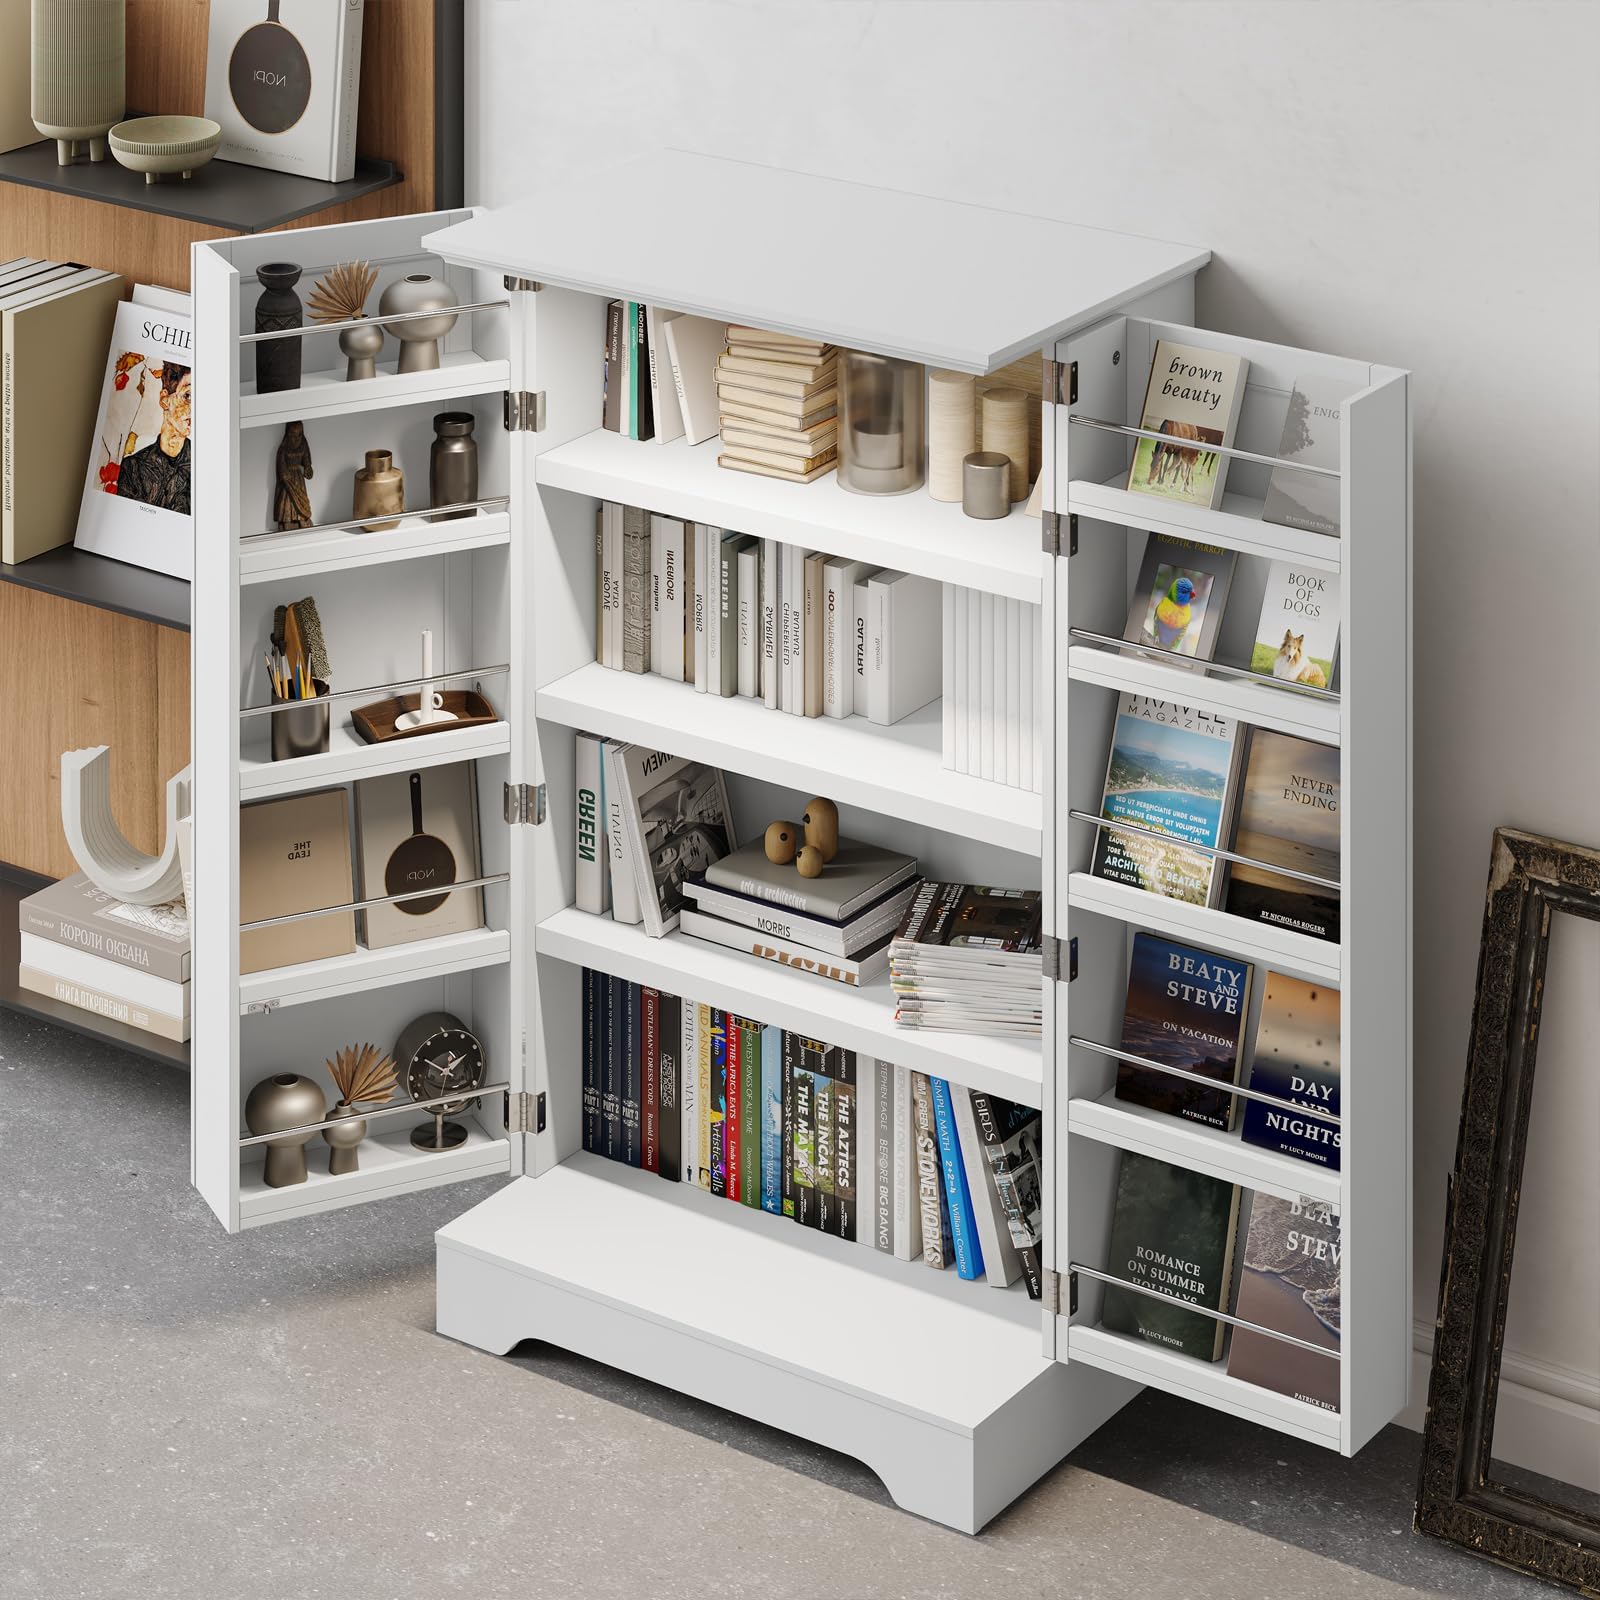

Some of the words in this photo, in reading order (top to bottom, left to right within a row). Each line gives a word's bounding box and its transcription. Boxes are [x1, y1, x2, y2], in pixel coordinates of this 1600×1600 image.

[1168, 356, 1223, 383] brown
[1161, 378, 1221, 410] beauty
[1288, 572, 1326, 592] BOOK
[1296, 588, 1313, 602] OF
[1283, 598, 1321, 618] DOGS
[1128, 704, 1227, 738] MAGAZINE
[1290, 774, 1334, 796] NEVER
[1136, 801, 1171, 816] PERSPICIATIS
[1172, 810, 1188, 820] UNDE
[1190, 814, 1207, 825] OMNIS
[1283, 791, 1338, 812] ENDING
[1113, 805, 1126, 814] ISTE
[1126, 808, 1144, 818] NATUS
[1146, 813, 1164, 824] ERROR
[1165, 818, 1174, 826] SIT
[1175, 822, 1210, 837] VOLUPTATEM
[1107, 846, 1121, 854] TORE
[1108, 836, 1127, 846] EAQUE
[1103, 868, 1119, 878] VITAE
[1120, 872, 1136, 883] DICTA
[1166, 872, 1201, 889] BEATAE
[757, 917, 791, 938] MORRIS
[1261, 910, 1269, 918] BY
[1270, 912, 1300, 926] NICHOLAS
[1301, 920, 1326, 934] ROGERS
[60, 921, 103, 951] КОРОЛИ
[106, 938, 150, 967] ОКЕАНА
[1168, 953, 1241, 988] BEATY
[55, 982, 79, 1005] КНИГА
[80, 990, 128, 1021] ОТКРОВЕНИЯ
[1166, 980, 1238, 1015] STEVE
[1214, 985, 1239, 998] AND
[1162, 1020, 1178, 1032] ON
[1180, 1026, 1233, 1049] VACATION
[700, 1029, 709, 1090] ANIMALS
[746, 1088, 753, 1100] OF
[879, 1062, 888, 1098] STEPHEN
[916, 1078, 925, 1098] JIM
[1290, 1076, 1334, 1101] DAY
[584, 1093, 596, 1107] PART
[596, 1095, 600, 1108] 1
[602, 1100, 614, 1113] PART
[614, 1101, 620, 1113] 2
[622, 1105, 633, 1120] PART
[634, 1108, 639, 1120] 3
[666, 1094, 672, 1108] OF
[685, 1082, 694, 1113] MAN
[798, 1086, 809, 1116] THE
[818, 1093, 829, 1122] THE
[838, 1094, 849, 1124] THE
[933, 1079, 945, 1117] SIMPLE
[879, 1100, 888, 1130] EAGLE
[918, 1098, 929, 1130] GREEN
[975, 1098, 997, 1143] BIRDS
[1182, 1109, 1208, 1122] PATRICK
[1208, 1116, 1224, 1127] BECK
[712, 1122, 722, 1160] Artistic
[766, 1119, 774, 1158] WITHOUT
[798, 1118, 809, 1170] MAYA
[940, 1119, 951, 1152] MATH
[1266, 1111, 1341, 1148] NIGHTS
[818, 1124, 829, 1177] INCAS
[838, 1127, 849, 1188] AZTECS
[879, 1138, 888, 1184] BEFORE
[1288, 1146, 1304, 1155] LUCY
[1304, 1150, 1328, 1162] MOORE
[712, 1164, 722, 1192] Skills
[729, 1161, 736, 1172] M.
[766, 1160, 774, 1196] WHALES
[879, 1186, 888, 1206] BIG
[918, 1130, 941, 1265] STONEWORKS
[879, 1207, 888, 1248] BANG!
[952, 1203, 962, 1237] William
[956, 1238, 968, 1274] Counter
[1136, 1246, 1201, 1277] ROMANCE
[1127, 1260, 1148, 1275] ON
[1150, 1267, 1206, 1295] SUMMER
[1138, 1327, 1146, 1335] BY
[1146, 1329, 1162, 1340] LUCY
[1162, 1335, 1184, 1348] MOORE
[1294, 1392, 1320, 1406] PATRICK
[1320, 1400, 1336, 1412] BECK
